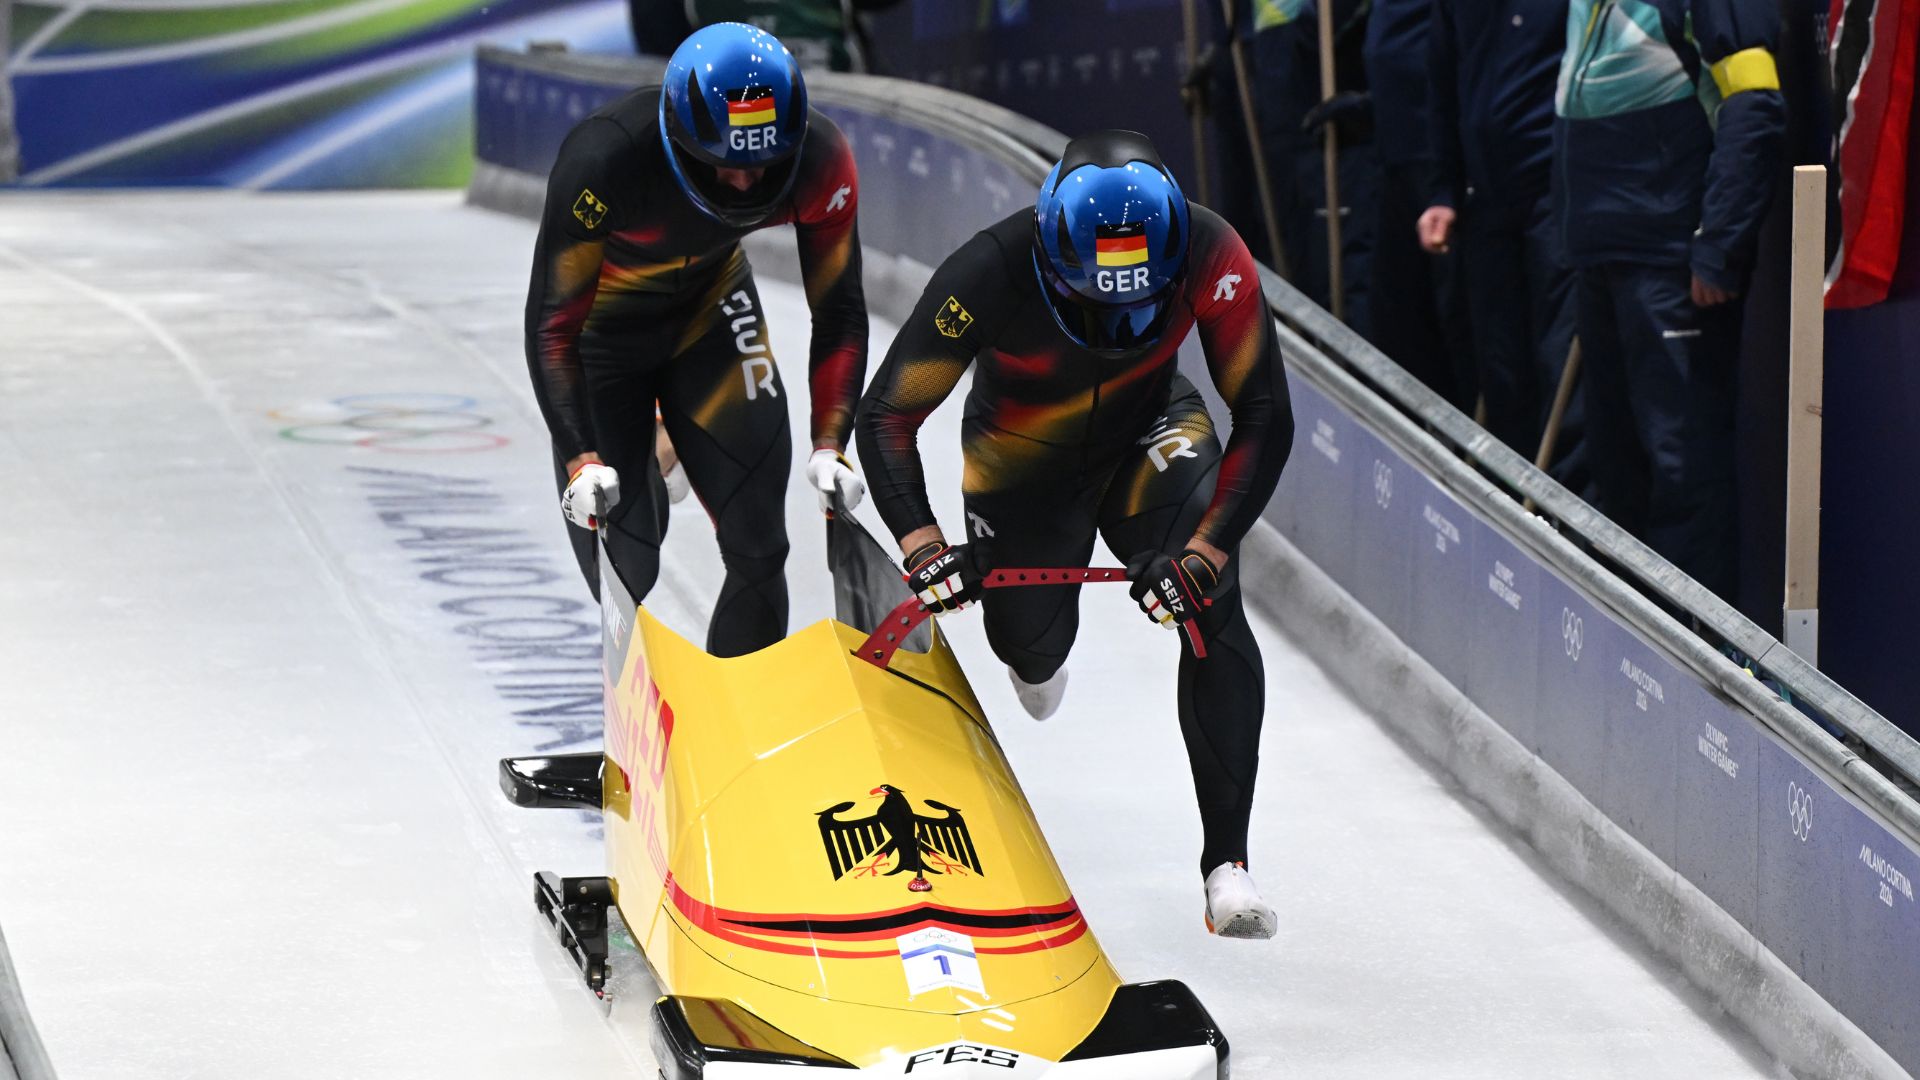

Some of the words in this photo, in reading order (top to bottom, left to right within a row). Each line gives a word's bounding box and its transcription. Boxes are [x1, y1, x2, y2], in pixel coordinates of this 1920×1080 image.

[730, 126, 777, 150] GER
[1097, 267, 1149, 292] GER
[919, 554, 955, 583] SEIZ
[1160, 578, 1185, 614] SEIZ
[1698, 734, 1718, 765] WINTER
[1705, 721, 1729, 753] OLYMPIC
[1859, 844, 1886, 879] MILANO
[1886, 863, 1914, 903] CORTINA
[1879, 880, 1893, 907] 2026
[933, 954, 952, 976] 1
[903, 1044, 1019, 1075] FES
